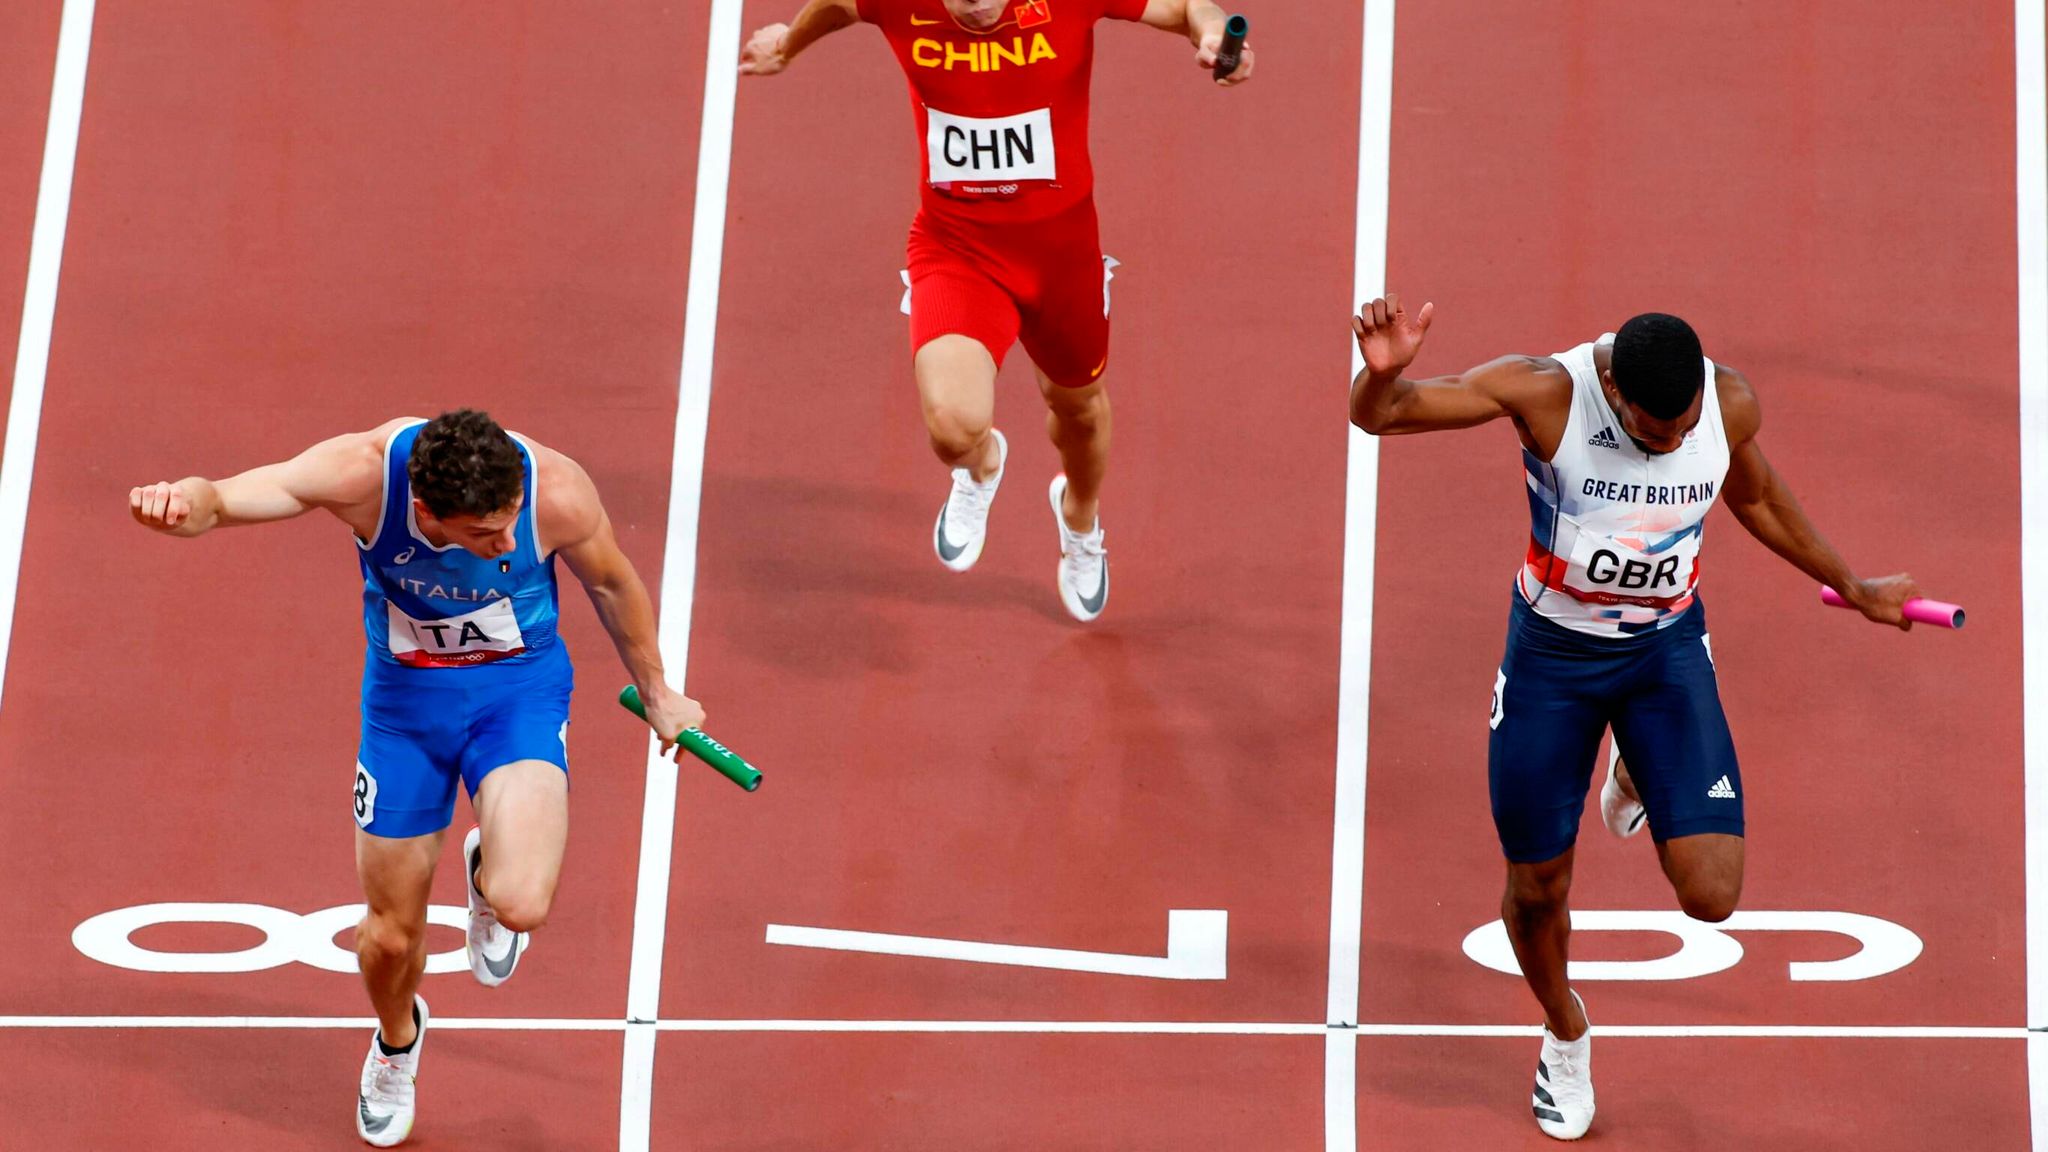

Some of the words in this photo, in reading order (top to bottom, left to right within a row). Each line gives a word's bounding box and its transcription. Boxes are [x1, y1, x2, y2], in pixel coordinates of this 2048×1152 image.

[911, 32, 1058, 73] CHINA
[943, 123, 1035, 170] CHN
[1588, 438, 1620, 450] adidas
[1582, 478, 1641, 503] GREAT
[1646, 480, 1714, 505] BRITAIN
[399, 577, 502, 601] ITALIA
[1586, 549, 1680, 589] GBR
[408, 620, 491, 649] ITA
[354, 771, 369, 818] 8
[71, 902, 530, 974] 8
[765, 909, 1228, 980] 7
[1462, 910, 1924, 981] 6
